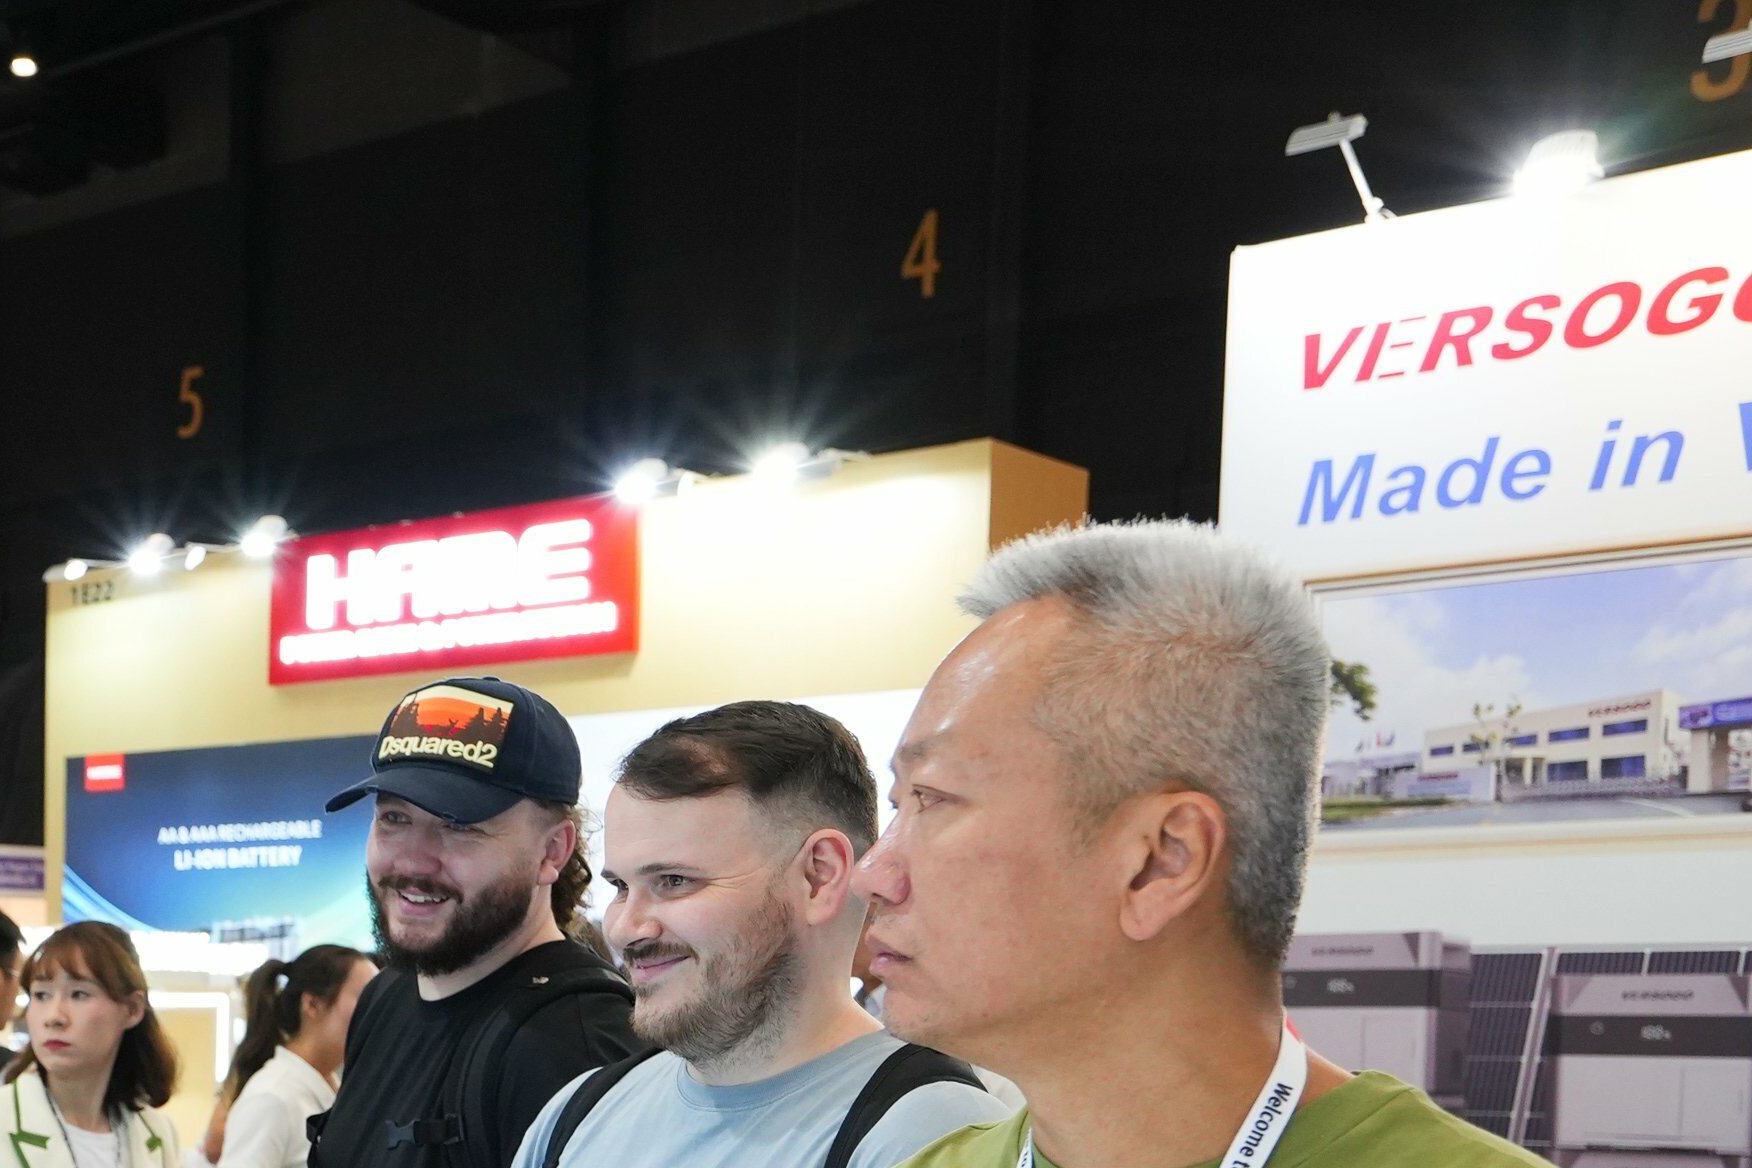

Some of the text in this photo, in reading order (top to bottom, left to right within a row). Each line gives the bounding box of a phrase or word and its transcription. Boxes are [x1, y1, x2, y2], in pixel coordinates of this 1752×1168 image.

[900, 208, 942, 298] 4
[1303, 266, 1752, 391] VERSOG
[176, 366, 205, 439] 5
[1297, 436, 1552, 527] Made
[1588, 420, 1686, 492] in
[70, 580, 115, 603] 1E22
[378, 735, 498, 769] Dsquared2
[1240, 1082, 1293, 1158] Welcome
